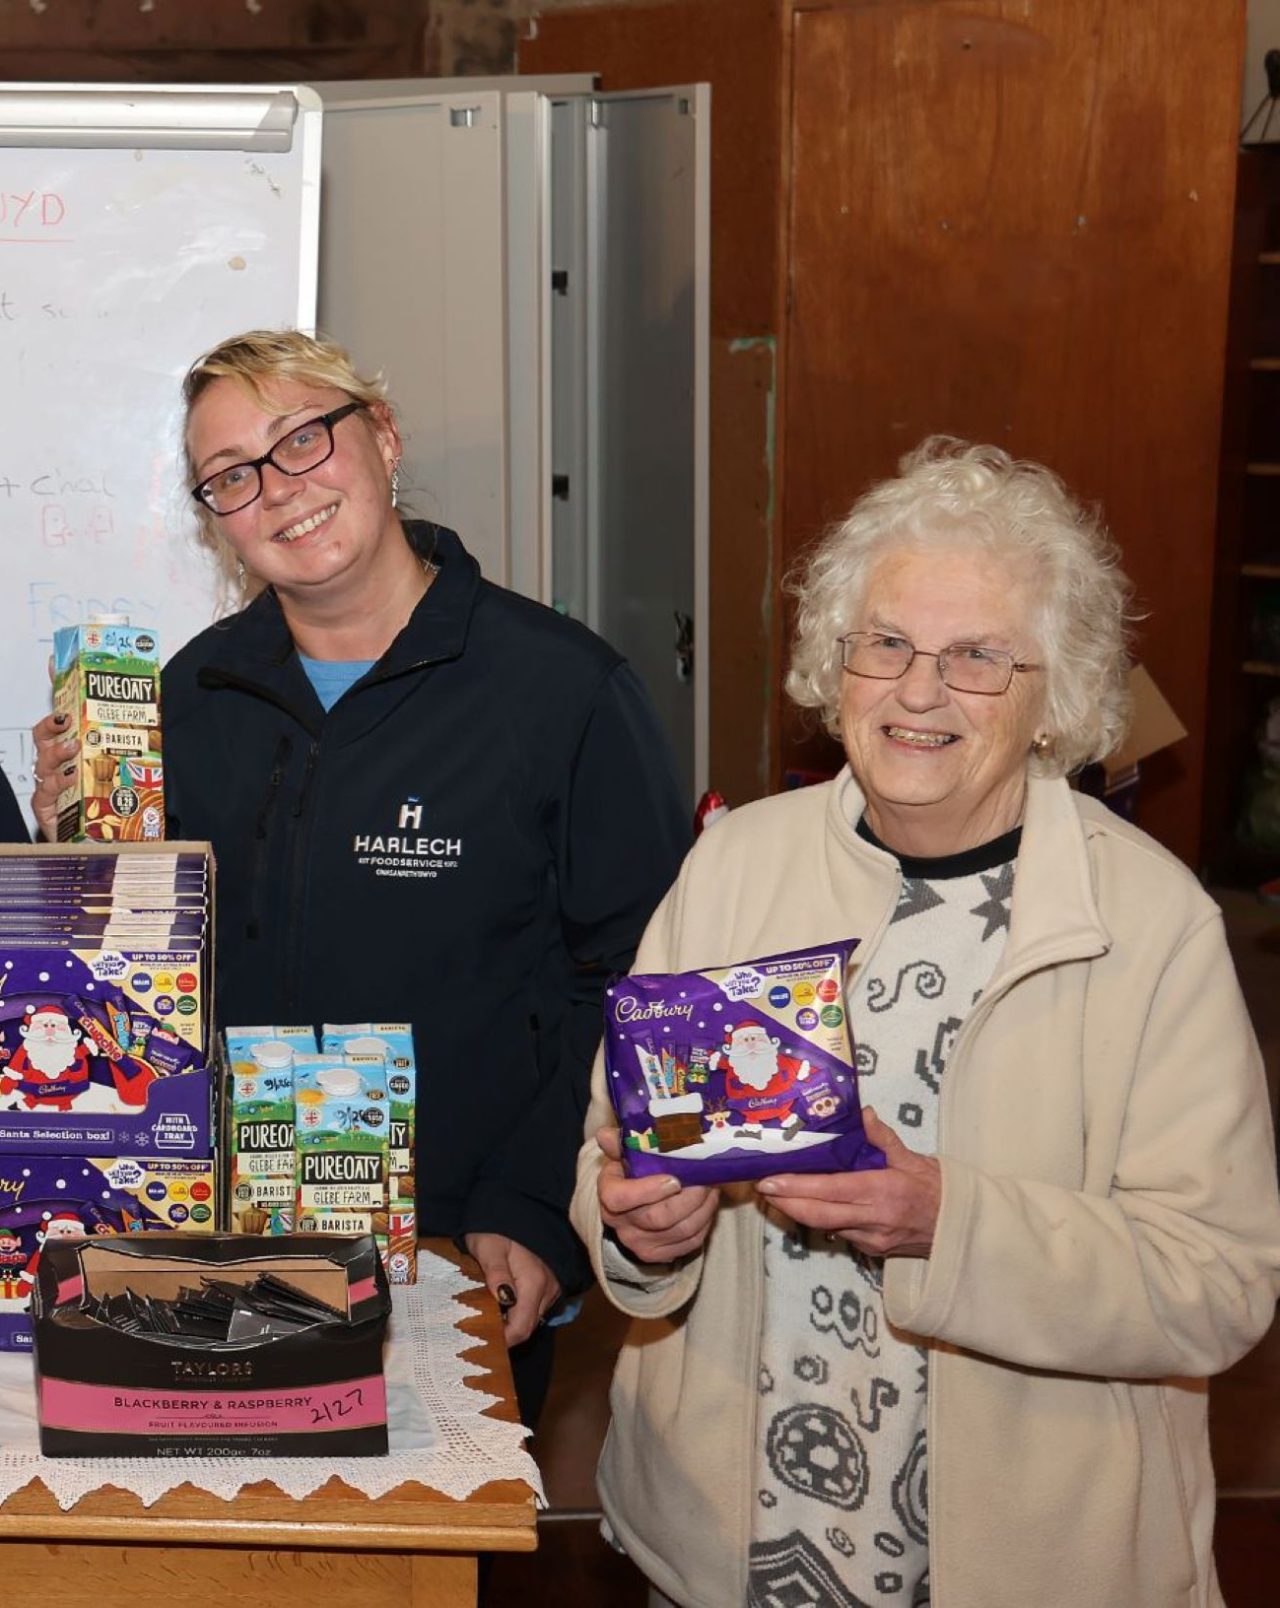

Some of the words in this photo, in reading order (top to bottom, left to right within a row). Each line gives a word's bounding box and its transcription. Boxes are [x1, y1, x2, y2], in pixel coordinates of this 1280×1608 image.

[88, 674, 152, 700] PUREOATY
[106, 733, 143, 746] BARISTA
[354, 835, 462, 856] HARLECH
[780, 964, 792, 972] TO
[615, 996, 694, 1022] Cadbury
[0, 1129, 30, 1138] Santa
[33, 1130, 83, 1140] Selection
[164, 1132, 186, 1140] TRAY
[304, 1156, 380, 1180] PUREOATY
[313, 1192, 341, 1205] GLEBE
[343, 1191, 371, 1204] FARM
[321, 1219, 364, 1231] BARISTA
[171, 1361, 255, 1377] TAYLORS
[113, 1396, 209, 1410] BLACKBERRY
[213, 1400, 223, 1409] &
[227, 1396, 313, 1410] RASPBERRY
[148, 1421, 174, 1429] FRUIT
[177, 1421, 232, 1429] FLAVOURED
[234, 1420, 279, 1429] INFUSION
[157, 1447, 181, 1457] NET
[183, 1447, 204, 1457] WT
